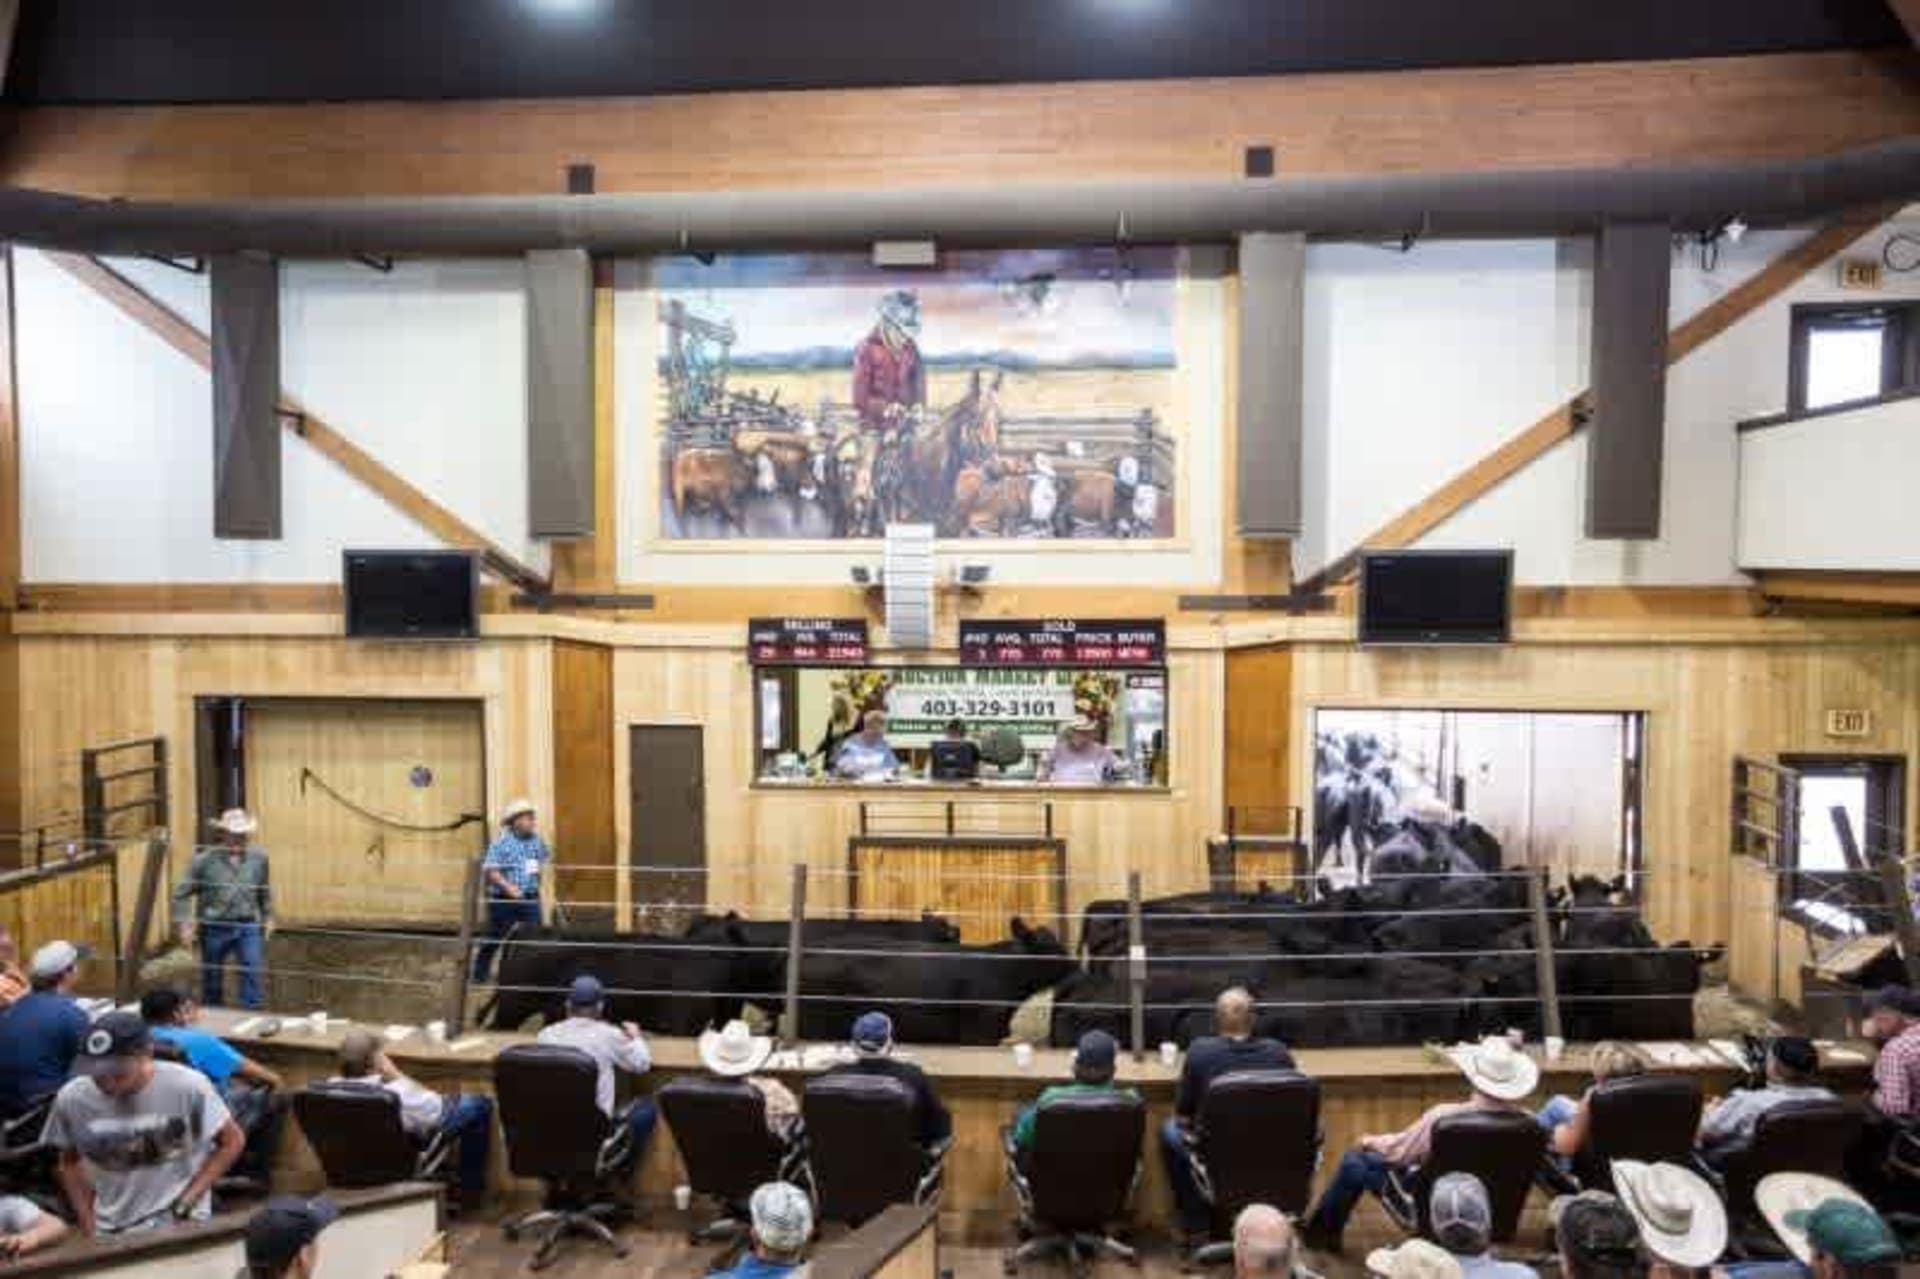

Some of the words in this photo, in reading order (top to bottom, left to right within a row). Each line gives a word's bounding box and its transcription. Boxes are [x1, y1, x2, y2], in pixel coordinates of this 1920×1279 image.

[1043, 620, 1076, 631] SOLD
[1029, 633, 1063, 644] TOTAL
[976, 671, 1046, 686] MARKET
[921, 699, 1056, 716] 403-329-3101
[1834, 712, 1864, 731] EXIT
